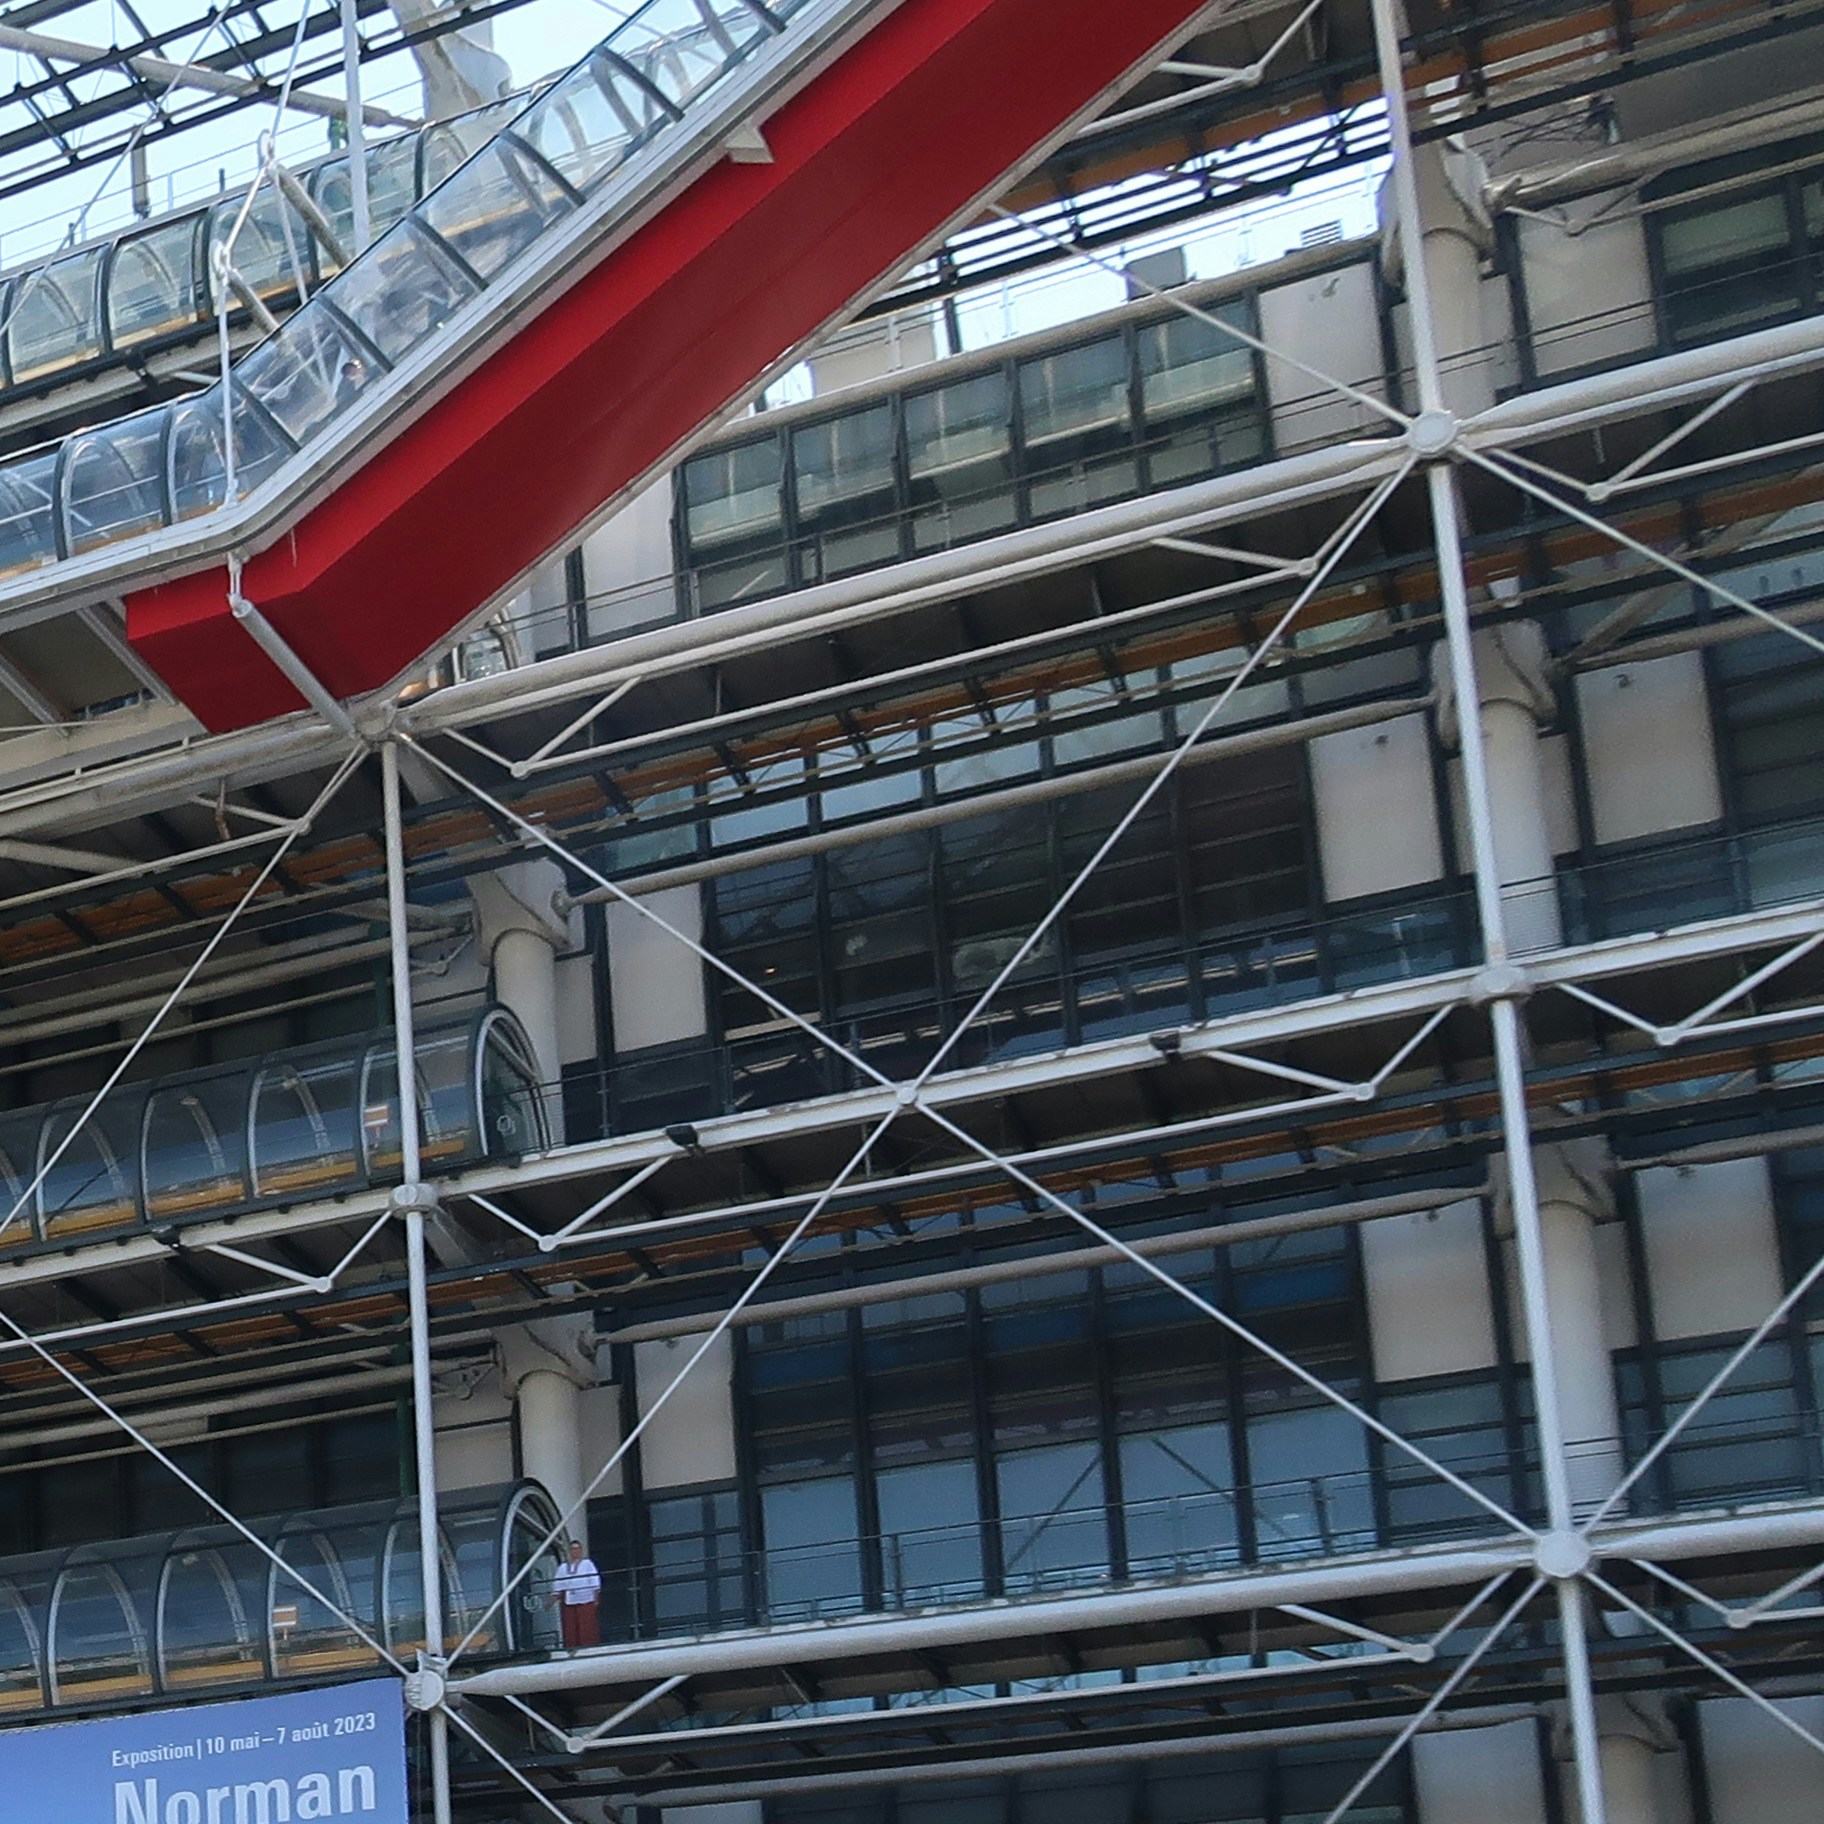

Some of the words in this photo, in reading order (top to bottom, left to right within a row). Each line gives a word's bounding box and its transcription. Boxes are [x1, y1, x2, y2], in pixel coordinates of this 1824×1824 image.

[112, 1743, 194, 1768] Exposition
[206, 1736, 225, 1754] 10
[230, 1731, 260, 1752] mai
[277, 1727, 287, 1744] 7
[292, 1721, 330, 1742] août
[334, 1712, 376, 1736] 2023
